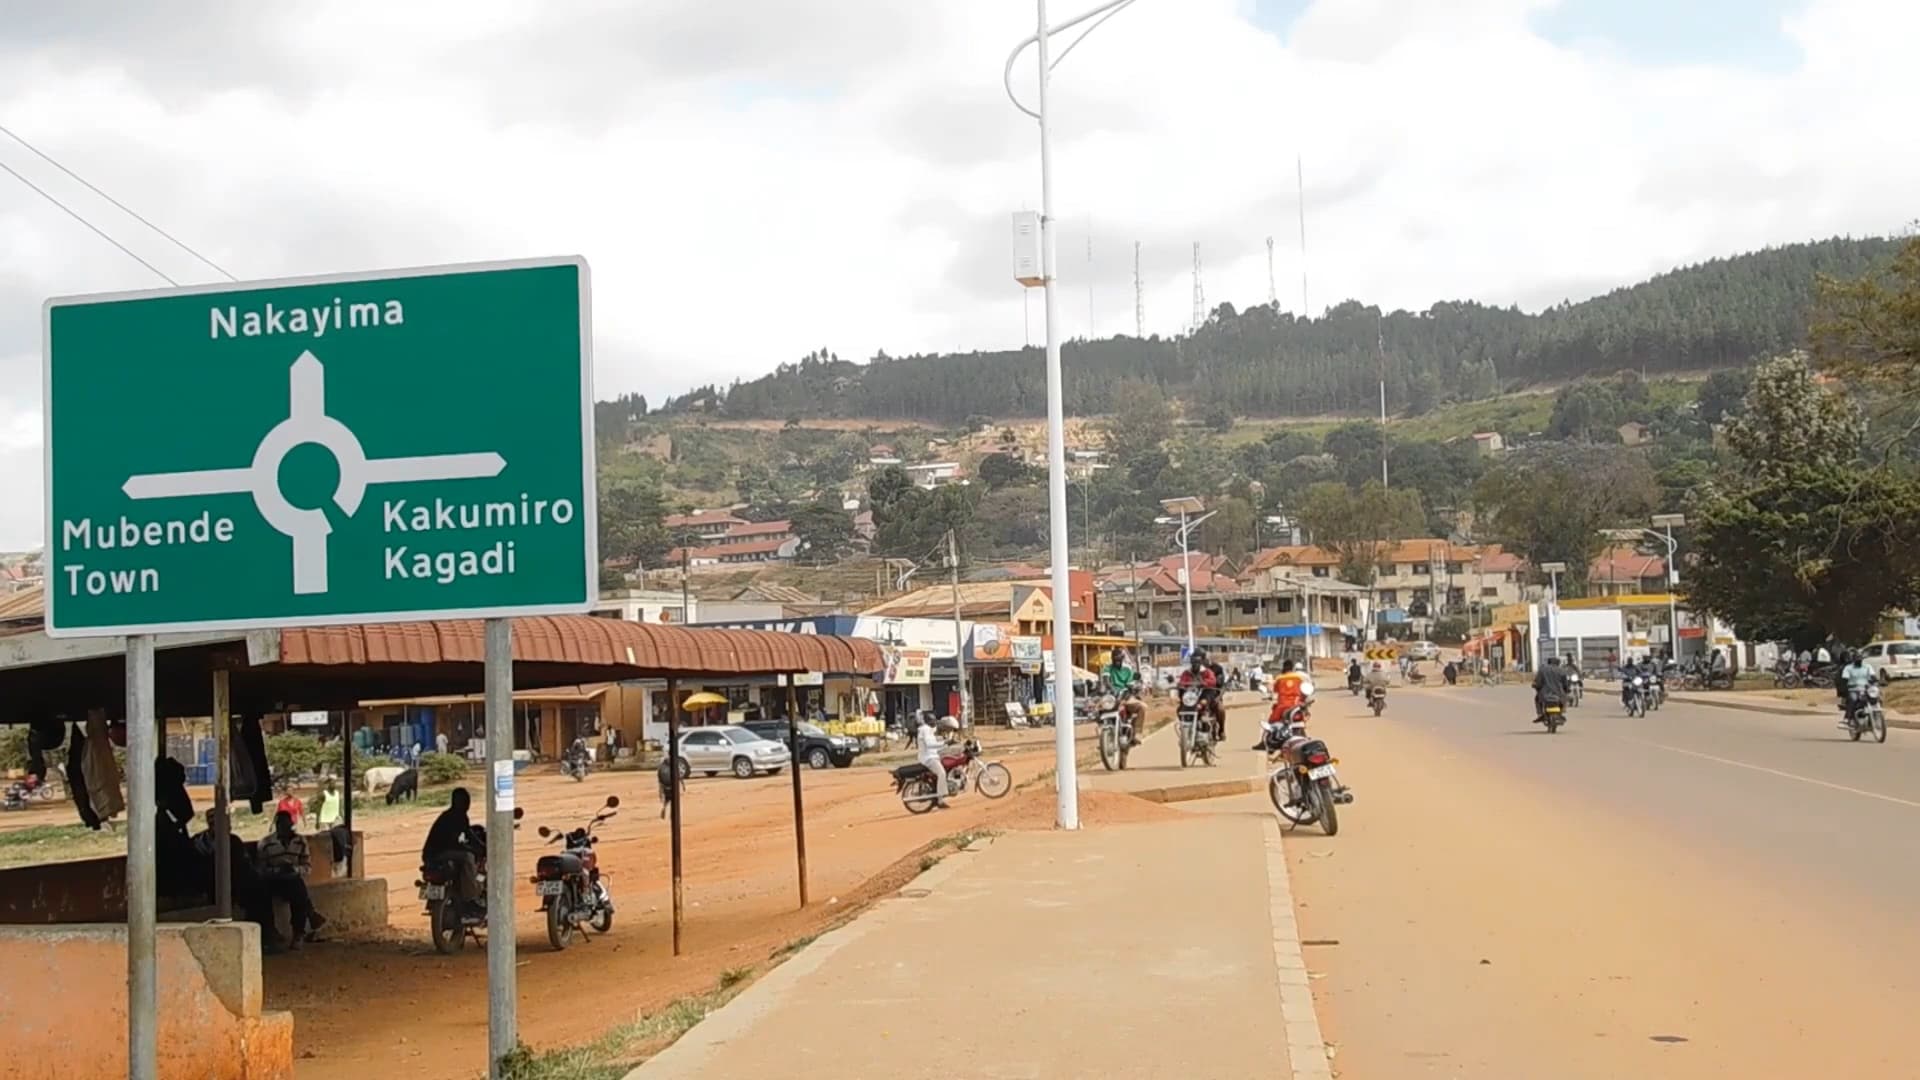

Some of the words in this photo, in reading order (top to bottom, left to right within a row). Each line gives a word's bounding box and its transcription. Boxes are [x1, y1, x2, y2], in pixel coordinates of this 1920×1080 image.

[211, 298, 404, 339] Nakayima
[63, 512, 234, 550] Mubende
[384, 493, 573, 532] Kakumiro
[64, 565, 159, 596] Town
[385, 541, 515, 584] Kagadi
